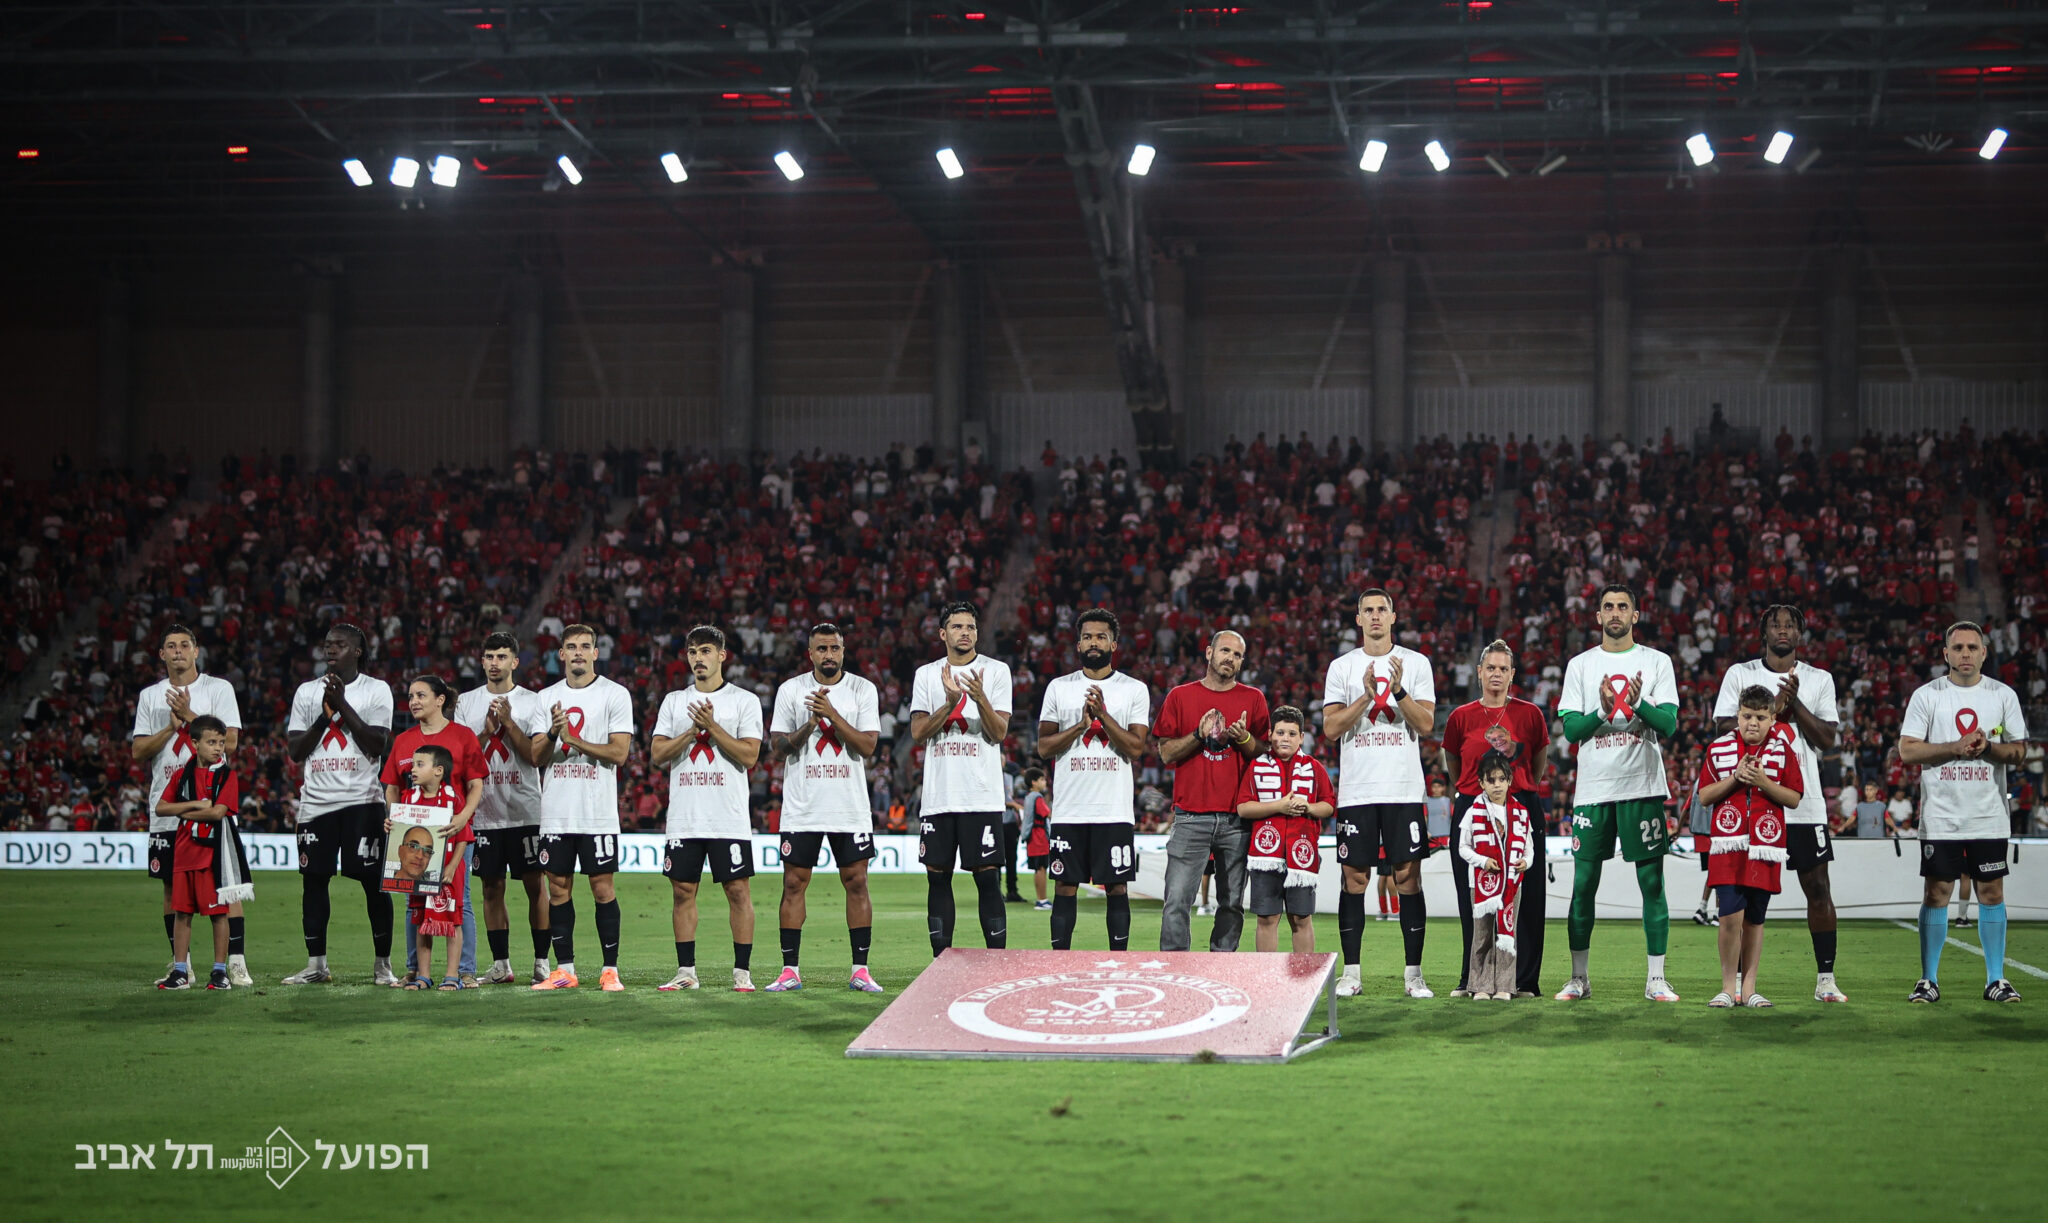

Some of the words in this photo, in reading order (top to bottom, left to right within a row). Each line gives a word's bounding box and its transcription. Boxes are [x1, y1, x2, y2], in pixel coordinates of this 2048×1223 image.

[946, 742, 961, 756] THEM
[1354, 733, 1370, 748] BRING
[1371, 732, 1386, 747] THEM
[1595, 734, 1612, 749] BRING
[1612, 731, 1627, 747] THEM
[311, 759, 325, 773] BRING
[325, 758, 340, 772] THEM
[553, 765, 567, 778] BRING
[568, 764, 582, 778] THEM
[805, 764, 822, 779] BRING
[822, 764, 838, 779] THEM
[1070, 757, 1086, 771] BRING
[1086, 757, 1101, 771] THEM
[1939, 766, 1957, 781] BRING
[1957, 766, 1973, 781] THEM
[491, 770, 504, 785] THEM
[679, 772, 693, 786] BRING
[693, 772, 708, 786] THEM
[981, 825, 996, 848] 4
[1409, 820, 1421, 844] 6
[1639, 817, 1663, 843] 22
[1814, 824, 1827, 848] 5
[5, 842, 71, 864] פועם
[83, 837, 135, 864] הלב
[243, 844, 289, 866] נרג
[357, 836, 380, 860] 44
[729, 842, 743, 865] 8
[1110, 845, 1132, 868] 98
[967, 973, 1079, 1000] HAPOEL
[1045, 1034, 1107, 1043] 1923
